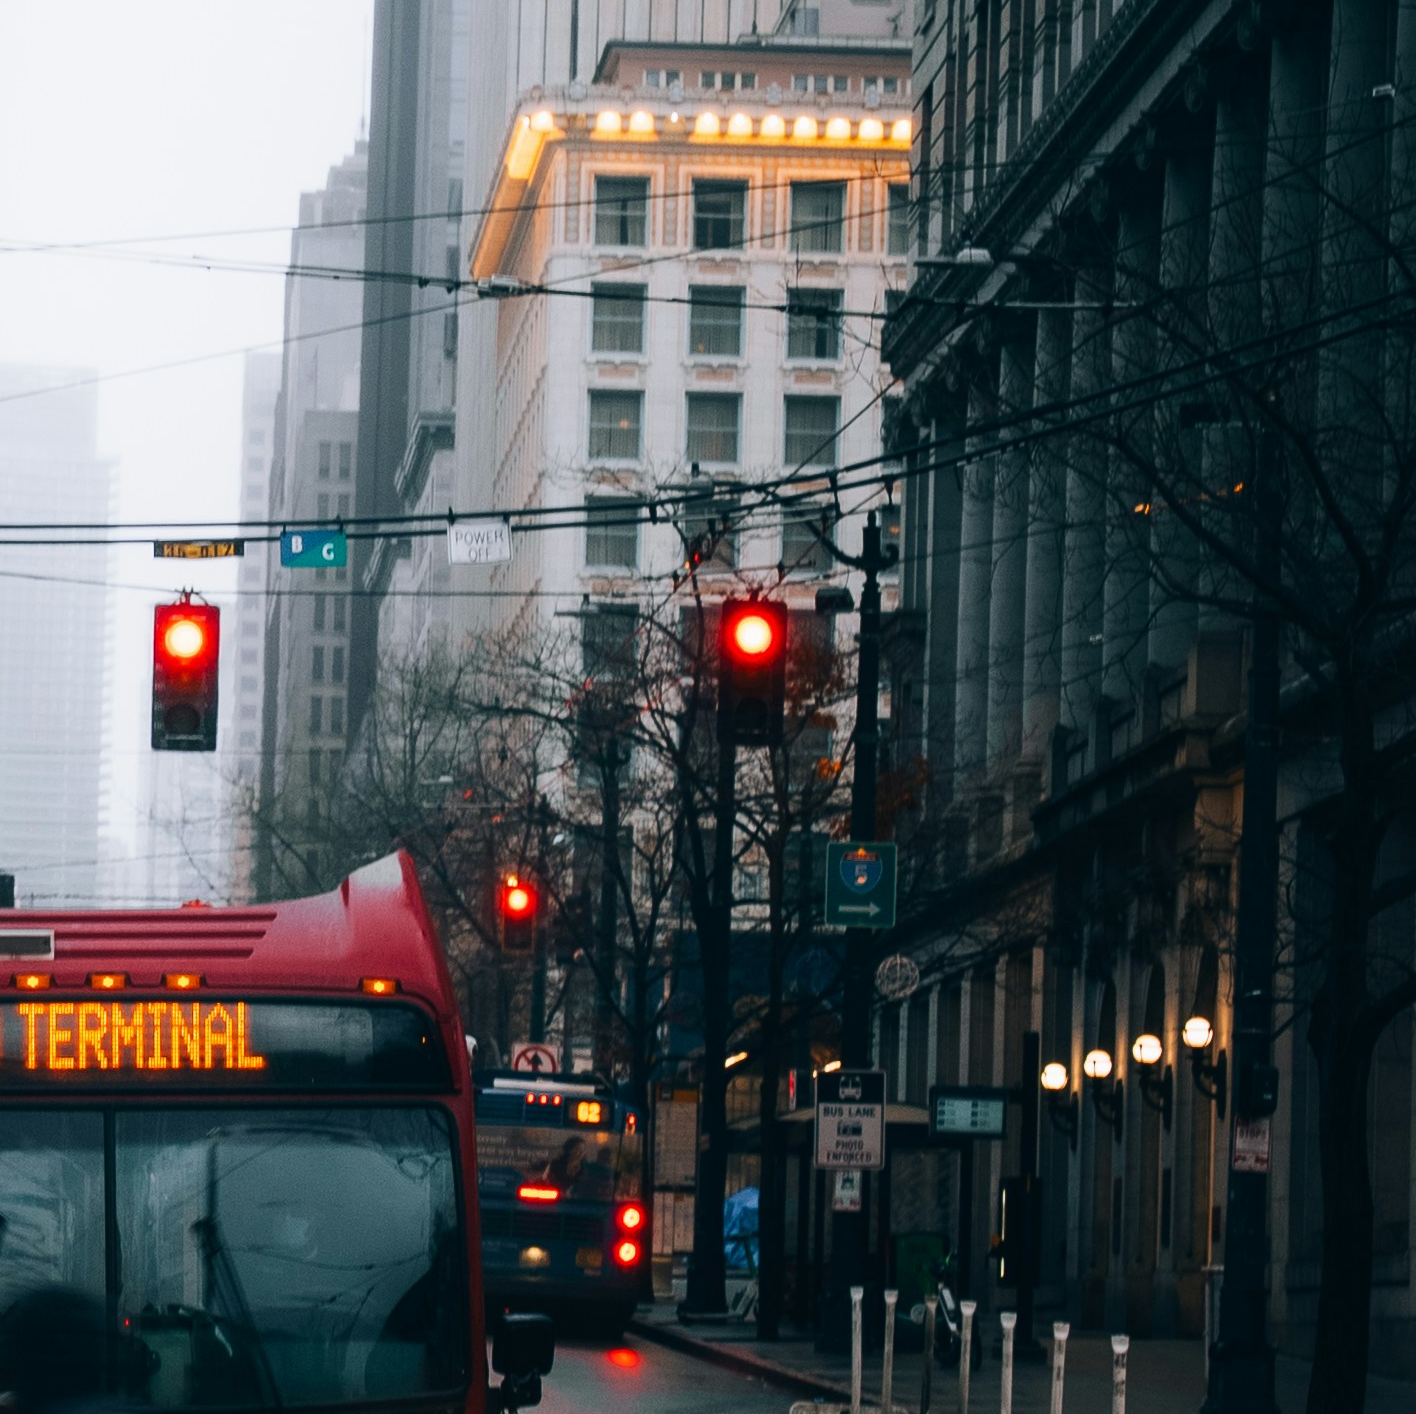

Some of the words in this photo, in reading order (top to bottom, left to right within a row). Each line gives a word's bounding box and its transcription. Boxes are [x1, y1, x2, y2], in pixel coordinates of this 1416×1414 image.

[292, 535, 302, 553] B
[455, 529, 504, 546] POWER
[468, 547, 492, 563] OFF
[19, 1002, 266, 1070] TERMINAL
[823, 1108, 844, 1118] BUS
[848, 1108, 876, 1118] LANE
[835, 1140, 864, 1150] PHOTO
[826, 1151, 872, 1163] ENFORCED
